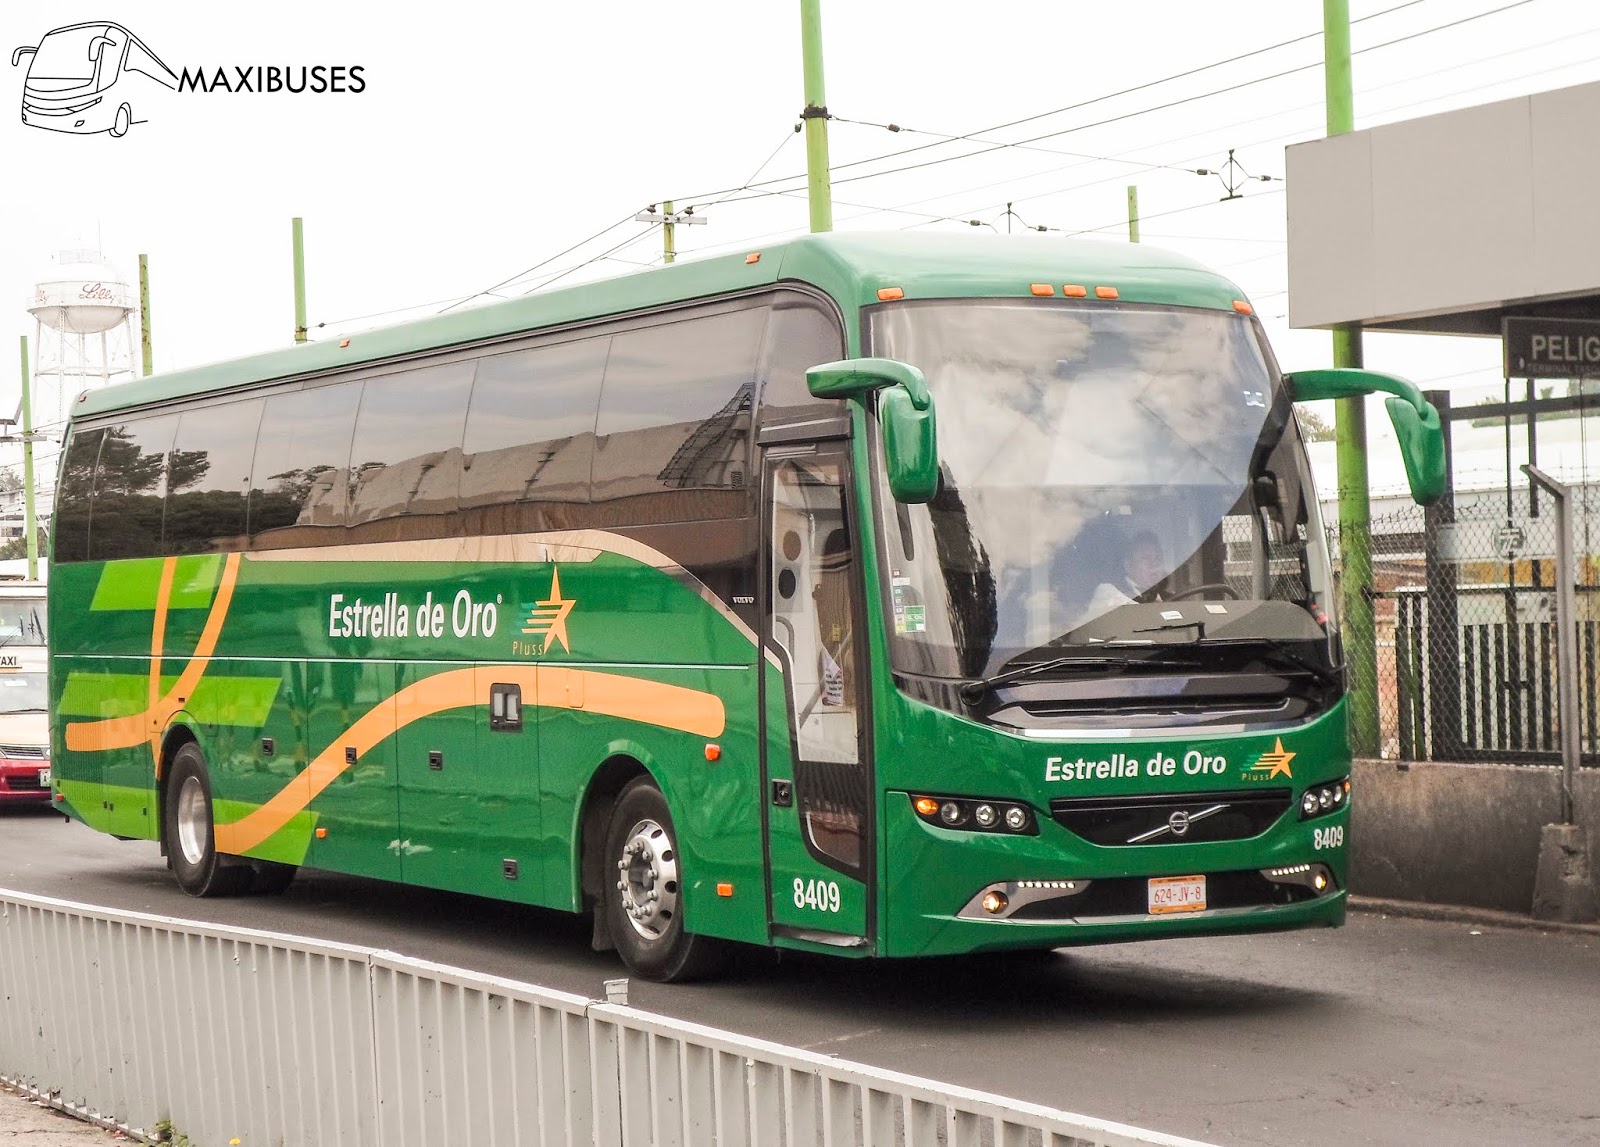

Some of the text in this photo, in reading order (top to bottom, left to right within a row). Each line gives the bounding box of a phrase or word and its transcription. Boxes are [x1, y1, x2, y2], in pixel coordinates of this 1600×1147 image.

[79, 282, 115, 304] Lilly
[733, 596, 754, 604] VOLVO
[329, 592, 408, 637] Estrella
[416, 592, 444, 637] de
[512, 641, 543, 655] Pluss
[0, 656, 17, 666] AXI
[1045, 750, 1227, 781] Estrella de Oro
[1313, 826, 1344, 850] 8409
[793, 877, 840, 912] 8409
